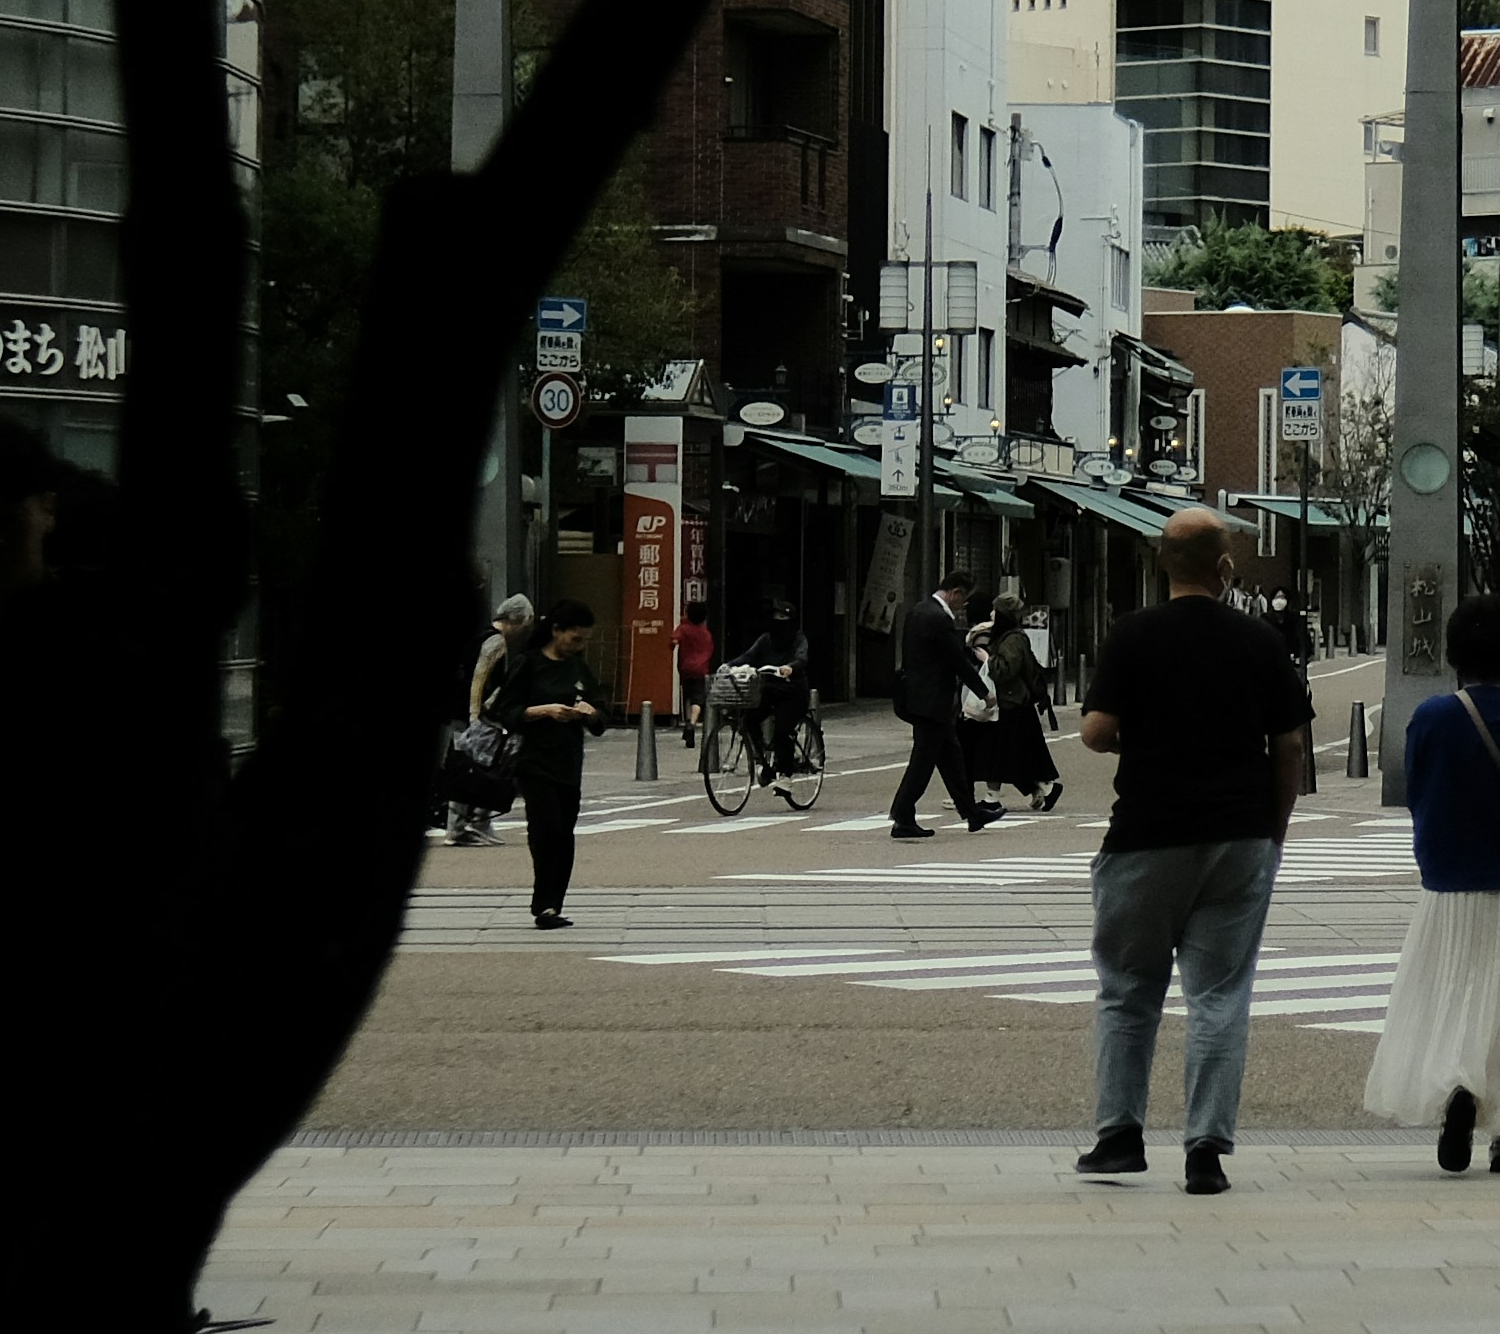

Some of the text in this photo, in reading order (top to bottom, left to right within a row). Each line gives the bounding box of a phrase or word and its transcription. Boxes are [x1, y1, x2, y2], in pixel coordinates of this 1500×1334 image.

[539, 354, 579, 368] ここから
[543, 389, 570, 413] 30
[1284, 422, 1318, 436] ここから
[636, 515, 667, 533] JP
[638, 544, 661, 611] 郵便局
[1409, 576, 1438, 662] 松山城
